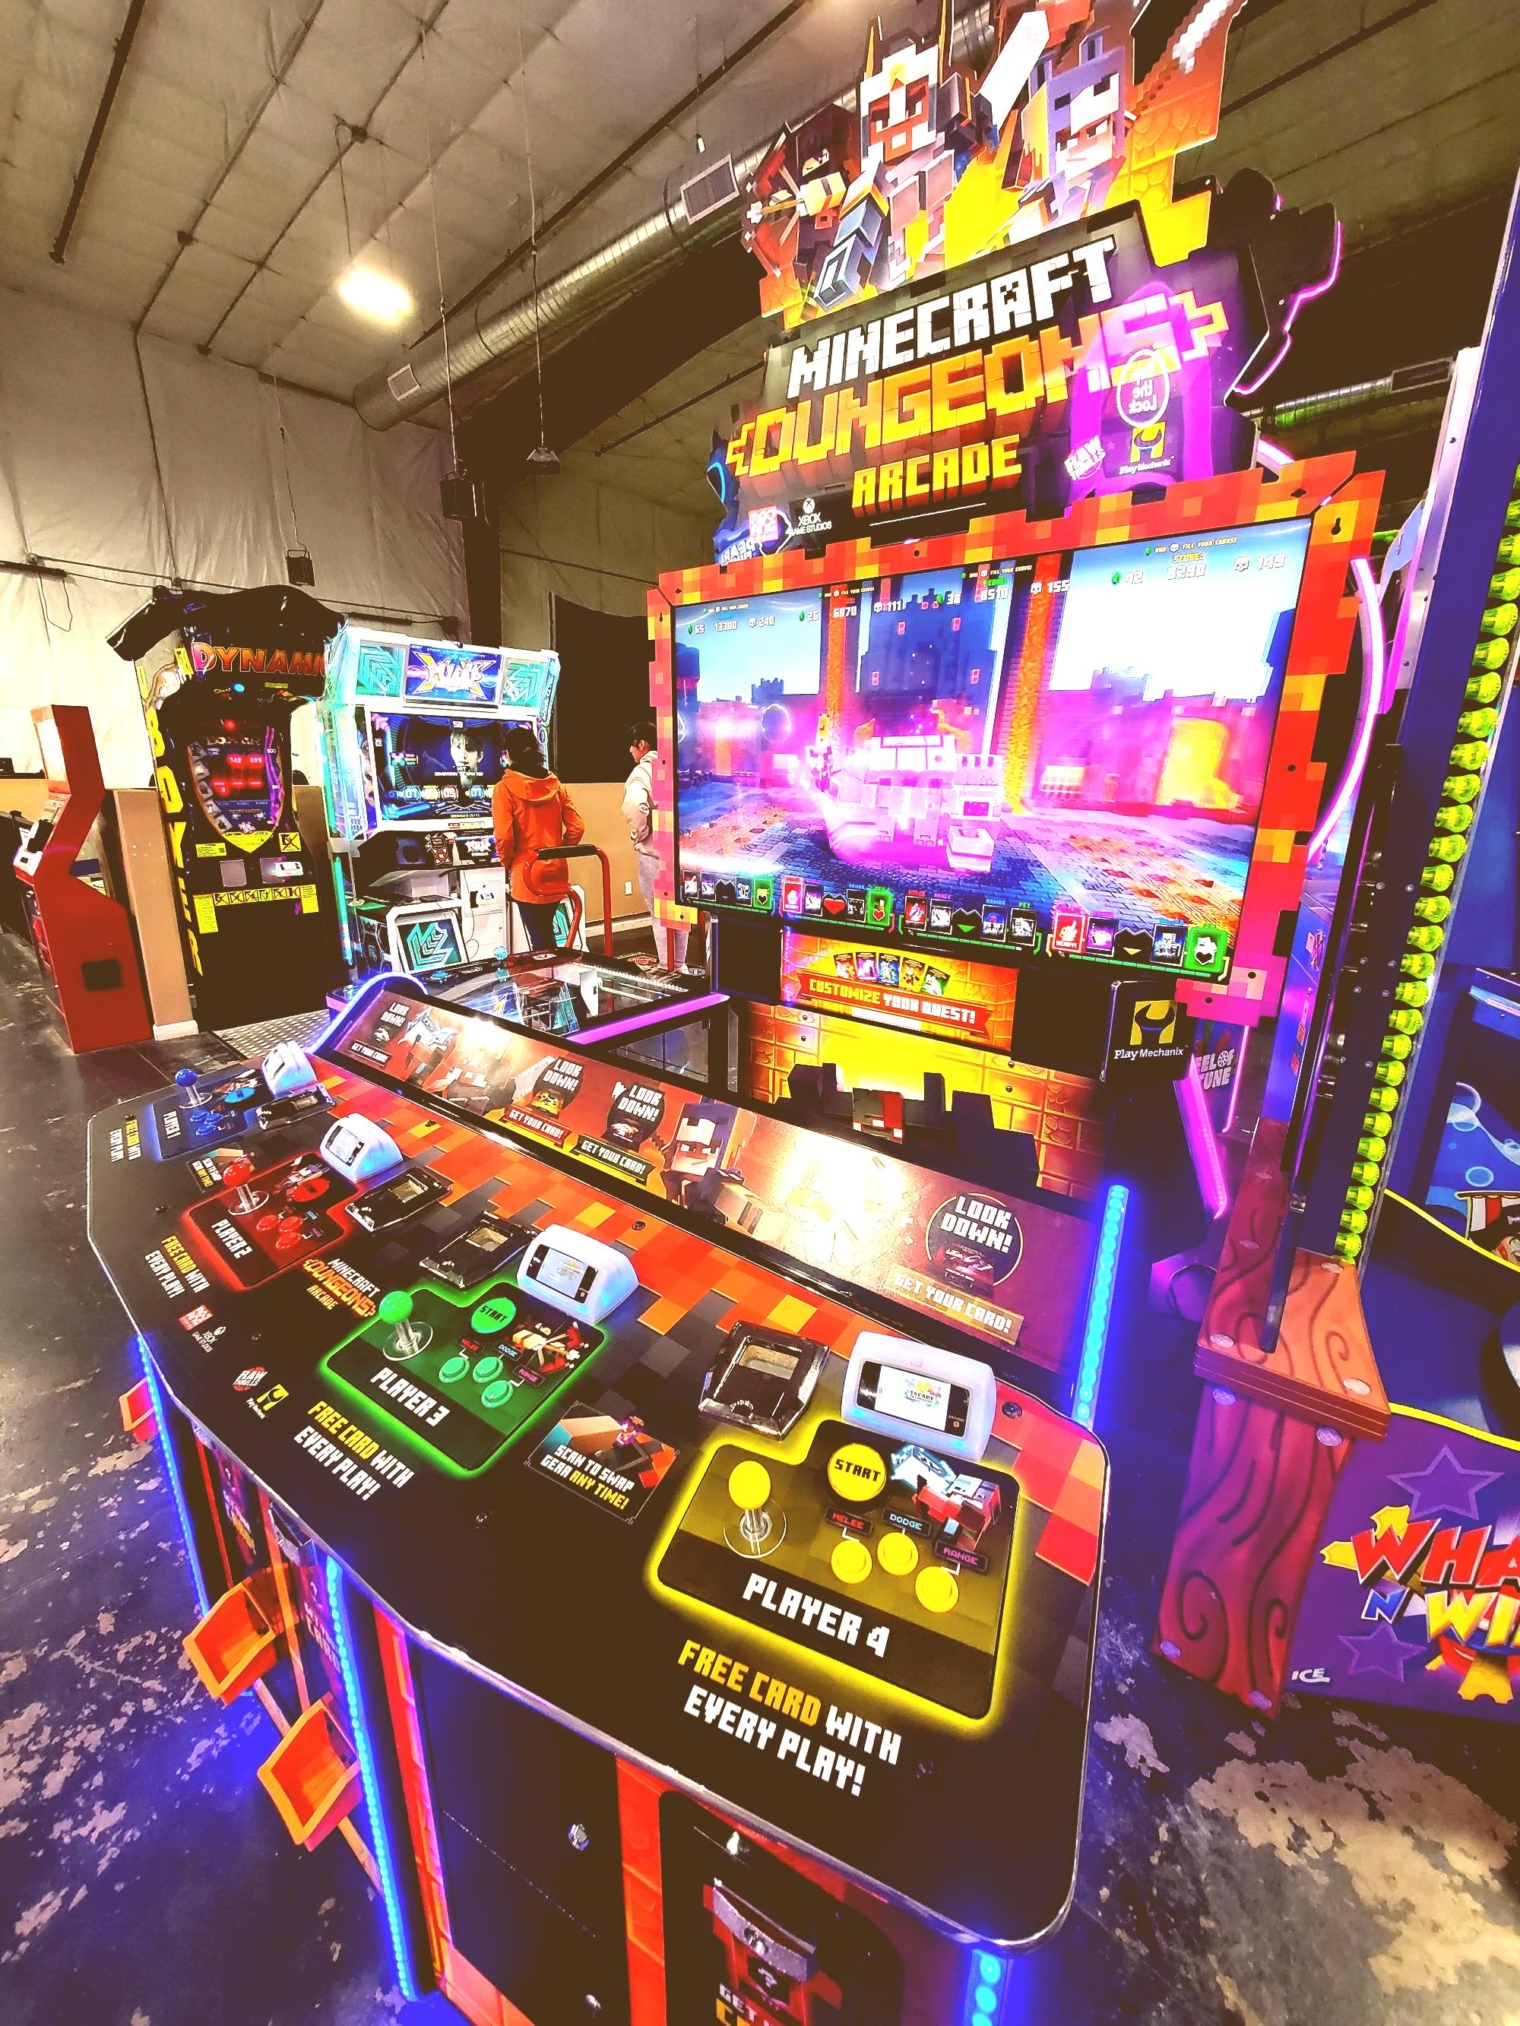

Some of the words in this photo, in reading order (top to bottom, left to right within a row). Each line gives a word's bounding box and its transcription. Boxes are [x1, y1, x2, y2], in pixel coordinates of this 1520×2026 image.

[788, 236, 1115, 399] MINECRAFT
[748, 295, 1183, 478] DUNGEONS
[1064, 435, 1101, 474] RAW
[852, 434, 1023, 511] ARCADE
[798, 512, 822, 526] XBOX
[806, 521, 833, 534] STUDIOS
[1173, 552, 1205, 563] SCORE:
[1257, 553, 1286, 570] 149
[1125, 570, 1143, 584] 42
[1166, 564, 1206, 580] 8290
[980, 587, 1009, 602] 8510
[1047, 580, 1070, 594] 155
[389, 1002, 410, 1016] LOOK
[809, 978, 881, 1005] CUSTOMIZE
[882, 993, 920, 1013] YOUR
[921, 1001, 976, 1025] QUEST!
[380, 1011, 406, 1028] DOWN!
[351, 1042, 364, 1052] GET
[361, 1046, 375, 1057] YOUR
[372, 1051, 389, 1063] CARD!
[1114, 1049, 1139, 1061] Play
[1139, 1047, 1184, 1058] Mechanix
[553, 1058, 583, 1077] LOOK
[543, 1069, 580, 1092] DOWN!
[629, 1084, 663, 1107] LOOK
[618, 1097, 660, 1122] DOWN!
[509, 1109, 523, 1122] GET
[523, 1115, 543, 1130] YOUR
[541, 1122, 564, 1139] CARD!
[581, 1139, 597, 1154] GET
[597, 1147, 622, 1165] YOUR
[619, 1156, 647, 1175] CARD!
[955, 1195, 1013, 1231] LOOK
[211, 1219, 248, 1253] PLAYER
[234, 1246, 253, 1259] 2
[940, 1212, 1014, 1254] DOWN!
[161, 1235, 185, 1257] FREE
[144, 1249, 172, 1277] EVERY
[158, 1271, 185, 1299] PLAY!
[172, 1252, 197, 1274] CARD
[184, 1268, 210, 1293] WITH
[303, 1259, 375, 1317] DUNGEONS
[327, 1258, 380, 1298] MINECRAFT
[306, 1284, 339, 1310] ARCADE
[895, 1273, 925, 1294] GET
[925, 1283, 965, 1312] YOUR
[964, 1302, 1013, 1334] CARD!
[479, 1305, 508, 1323] START
[498, 1344, 518, 1358] DODGE
[237, 1370, 268, 1381] RAW
[370, 1367, 438, 1418] PLAYER
[425, 1405, 451, 1427] 3
[307, 1400, 349, 1435] FREE
[337, 1424, 380, 1460] CARD
[370, 1449, 415, 1489] WITH
[293, 1425, 344, 1468] EVERY
[331, 1457, 381, 1501] PLAY!
[554, 1444, 586, 1468] SCAN
[584, 1459, 602, 1475] TO
[599, 1470, 636, 1493] SWAP
[834, 1458, 882, 1483] START
[540, 1454, 573, 1478] GEAR
[569, 1470, 596, 1491] ANY
[594, 1483, 630, 1510] TIME!
[832, 1512, 864, 1530] MELEE
[890, 1513, 923, 1531] DODGE
[943, 1547, 978, 1566] RANGE
[742, 1572, 862, 1646] PLAYER
[866, 1626, 891, 1659] 4
[1362, 1588, 1410, 1625] N
[1424, 1590, 1520, 1648] WI
[1292, 1668, 1331, 1684] ICE
[678, 1639, 745, 1691] FREE
[749, 1671, 822, 1728] CARD
[825, 1705, 902, 1766] WITH
[684, 1684, 778, 1750] EVERY
[777, 1728, 868, 1799] PLAY!
[719, 1982, 758, 2023] GET
